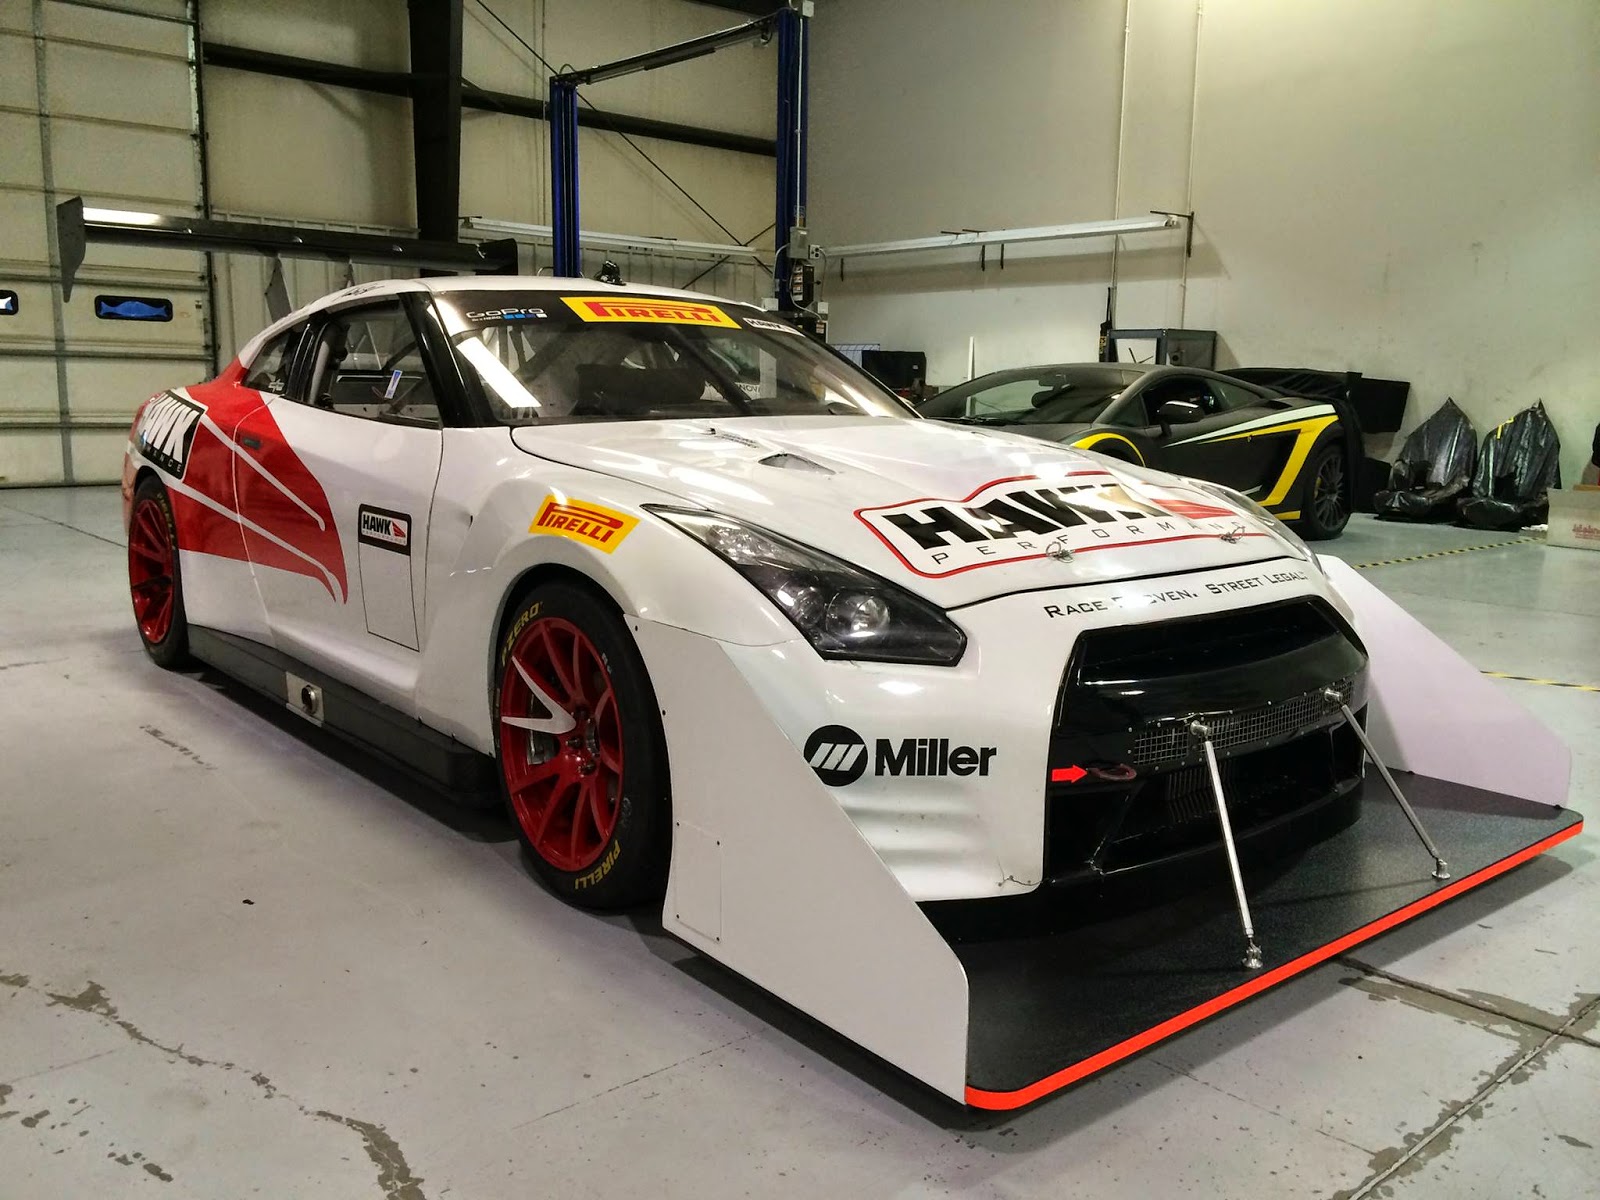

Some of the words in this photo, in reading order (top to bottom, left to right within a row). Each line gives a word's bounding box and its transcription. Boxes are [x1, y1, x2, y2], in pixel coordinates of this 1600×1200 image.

[466, 308, 544, 319] GoPro
[583, 301, 721, 322] PIRELLI
[362, 514, 392, 536] HAWK
[536, 502, 624, 543] PIRELLI
[932, 520, 1249, 565] PERFORMANC
[1043, 600, 1109, 618] RACE
[1110, 589, 1199, 608] VEN.
[1205, 577, 1264, 595] STREET
[874, 738, 997, 777] Miller
[574, 839, 621, 890] PIRELLI
